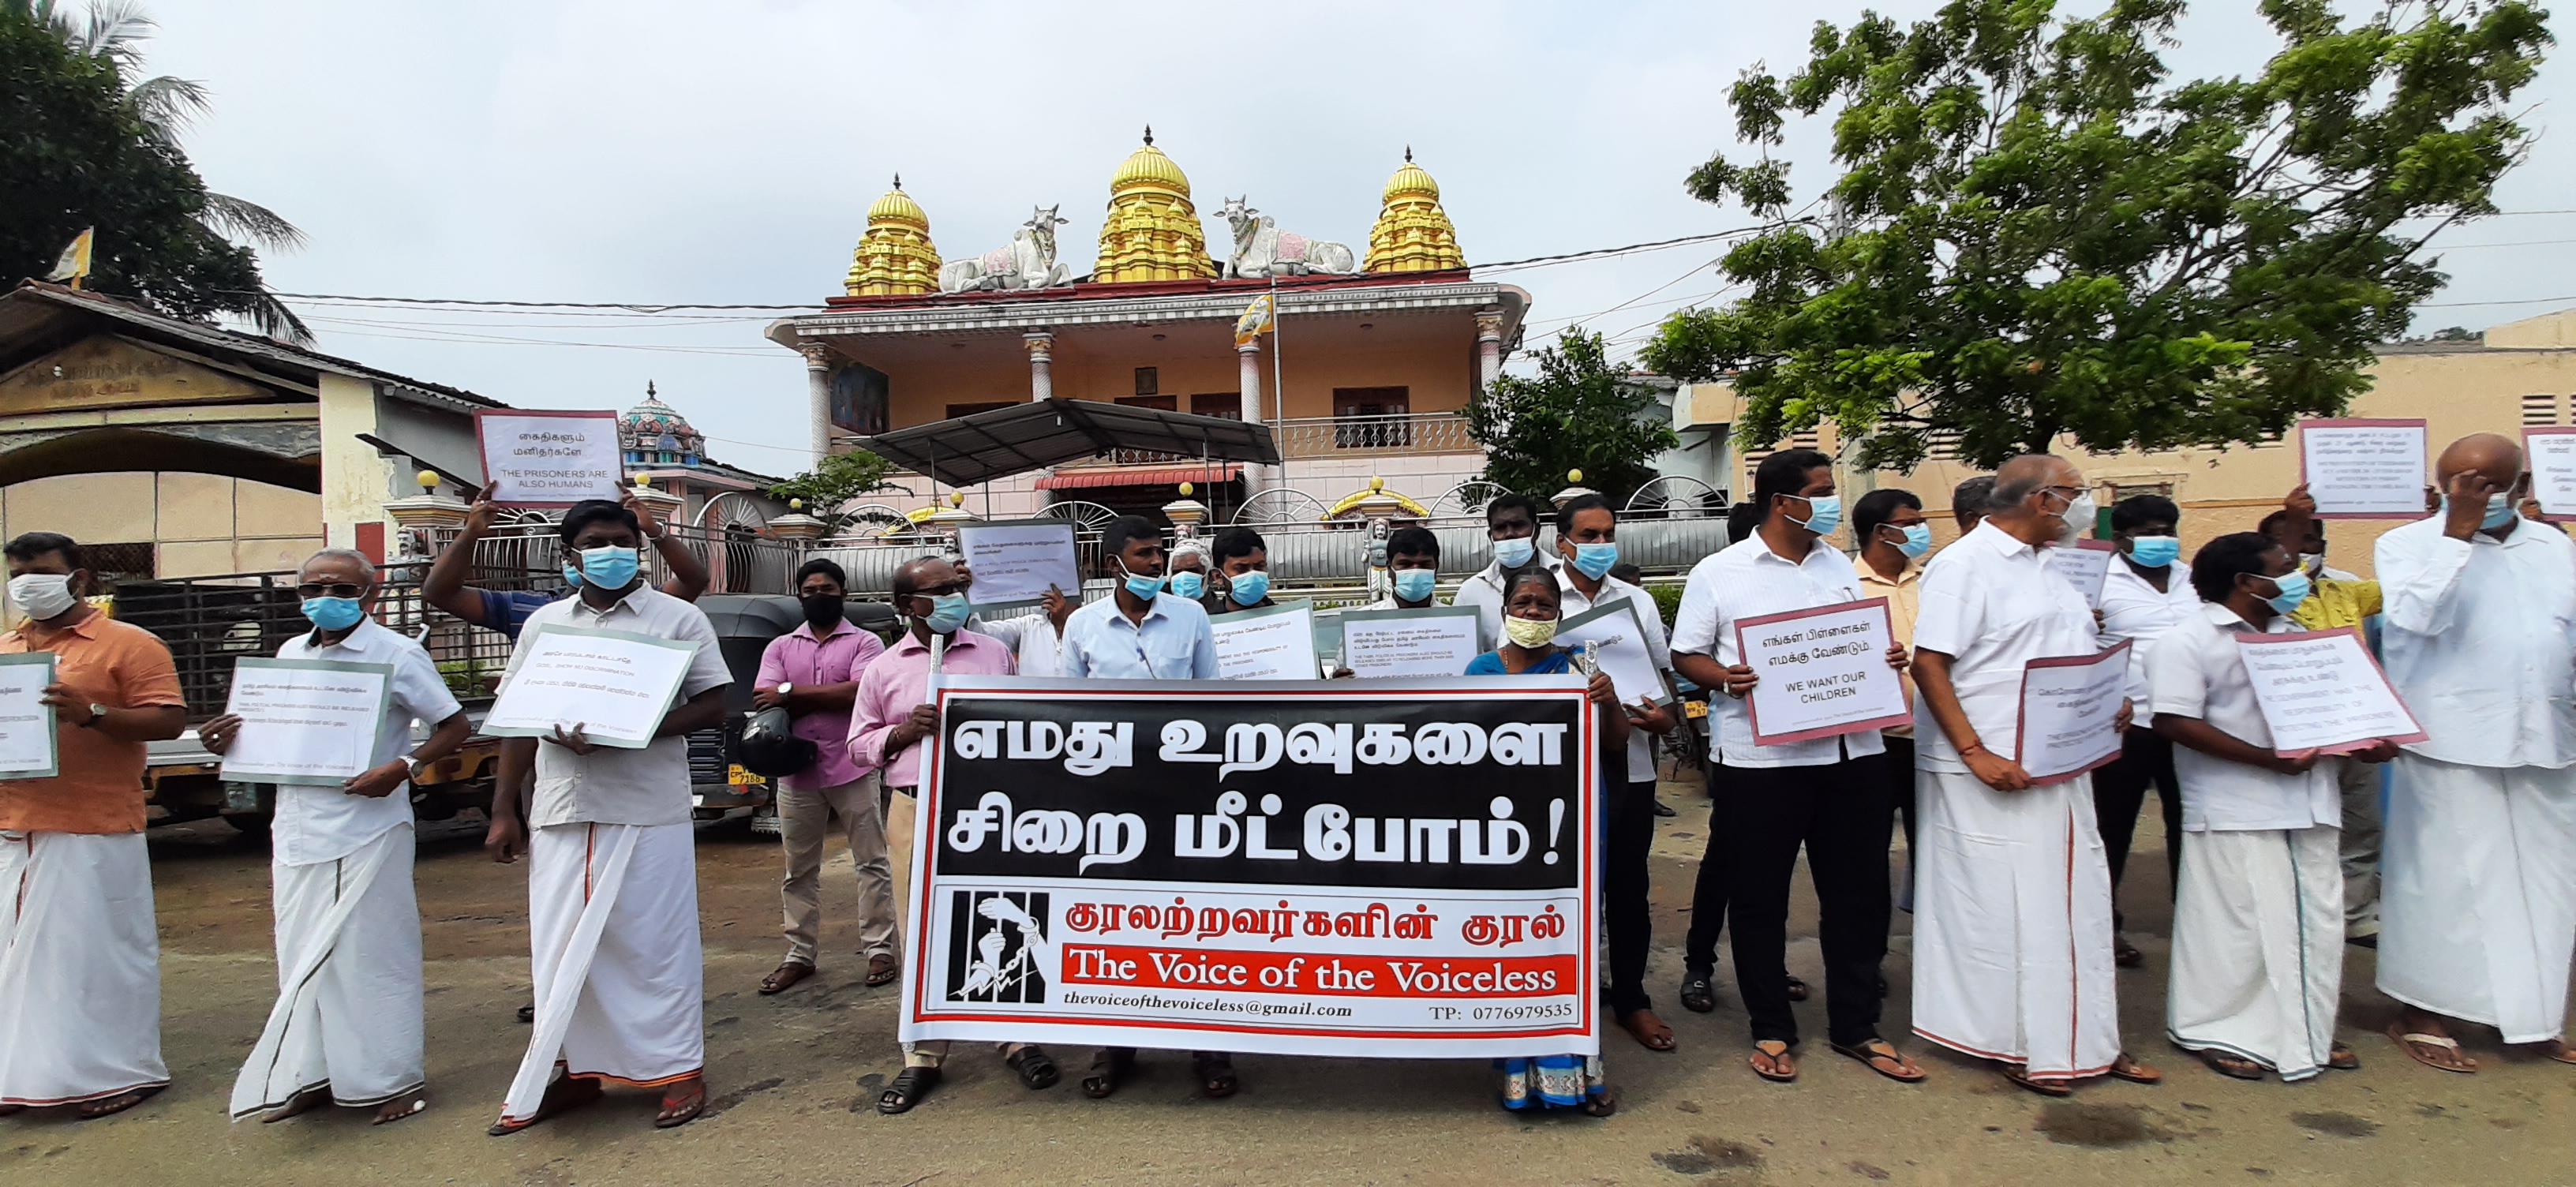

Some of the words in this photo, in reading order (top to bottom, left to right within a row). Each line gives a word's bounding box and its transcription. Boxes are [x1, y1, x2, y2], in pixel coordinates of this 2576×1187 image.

[519, 432, 585, 444] கைதிகளும்
[524, 470, 585, 478] PRISONERS
[1762, 631, 1803, 648] எங்கள்
[1806, 620, 1870, 641] பிள்ளைகள்
[1769, 652, 1810, 666] எமக்கு
[1785, 681, 1804, 692] WE
[1807, 676, 1838, 689] WANT
[1841, 671, 1866, 683] OUR
[1800, 686, 1856, 703] CHILDREN
[954, 720, 1134, 776] எமது
[1159, 720, 1567, 783] உறவுகளை
[948, 791, 1147, 875] சிறை
[1065, 897, 1439, 942] குரலற்றவர்களின்
[1462, 904, 1565, 948] குரல்
[1069, 948, 1136, 980] The
[1148, 952, 1248, 985] Voice
[1259, 957, 1305, 988] of
[1315, 959, 1375, 990] the
[1387, 961, 1556, 993] Voiceless
[1064, 991, 1352, 1017] thevoiceofthevoiceless@gmail.com
[1428, 1006, 1462, 1020] TP:
[1473, 1003, 1572, 1020] 0776979535
